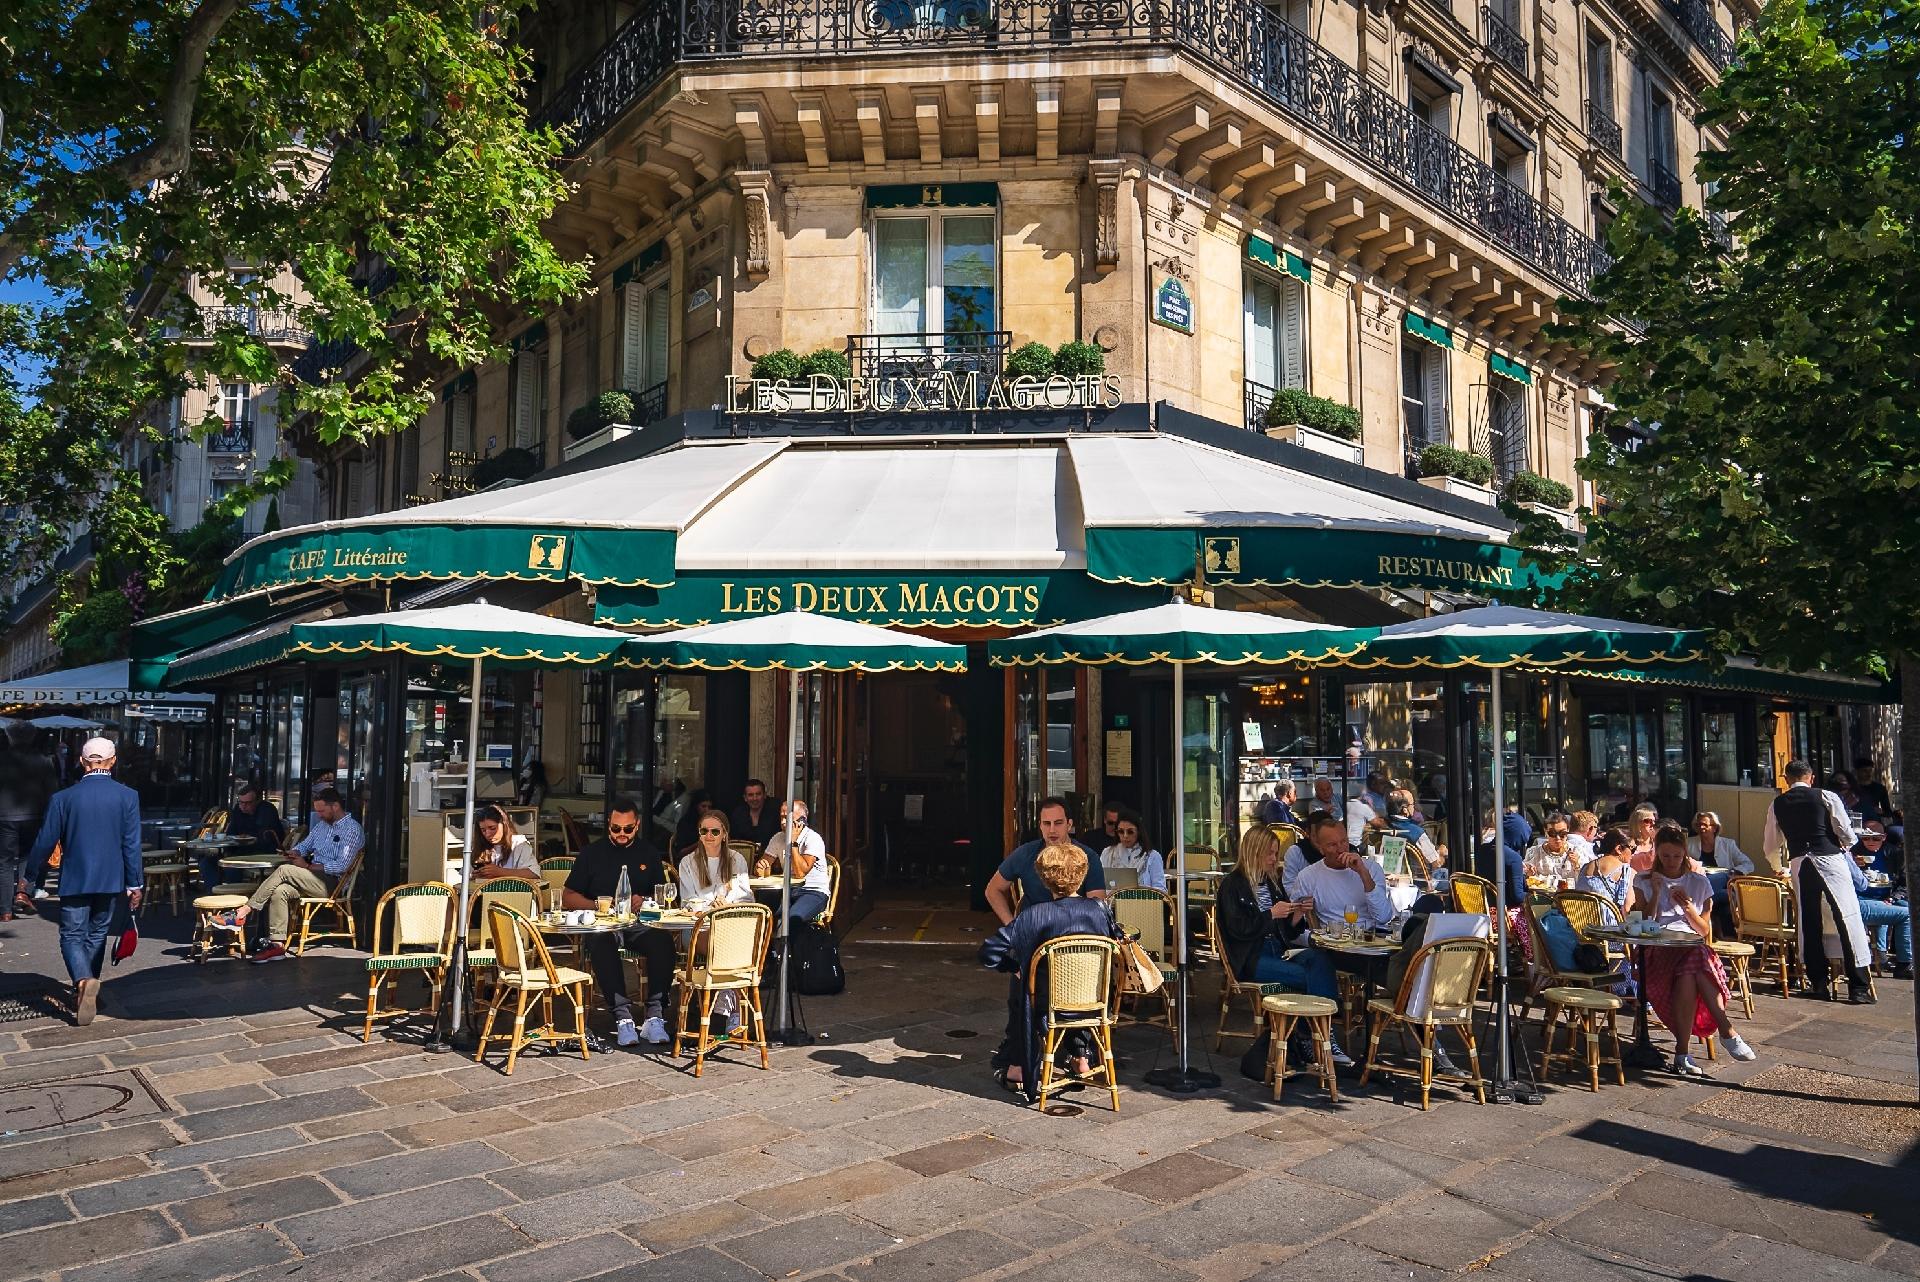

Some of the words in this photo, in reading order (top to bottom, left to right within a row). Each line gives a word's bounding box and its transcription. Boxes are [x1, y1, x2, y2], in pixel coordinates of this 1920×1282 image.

[724, 374, 793, 414] LES
[804, 373, 930, 413] DEUX
[939, 370, 1123, 411] MAGOTS
[333, 546, 407, 567] Littéraire
[1378, 555, 1513, 587] RESTAURANT
[720, 583, 782, 613] LES
[791, 582, 889, 613] DEUX
[897, 582, 1040, 613] MAGOTS
[0, 690, 25, 701] FE
[34, 690, 64, 701] DE
[75, 690, 167, 701] FLORE
